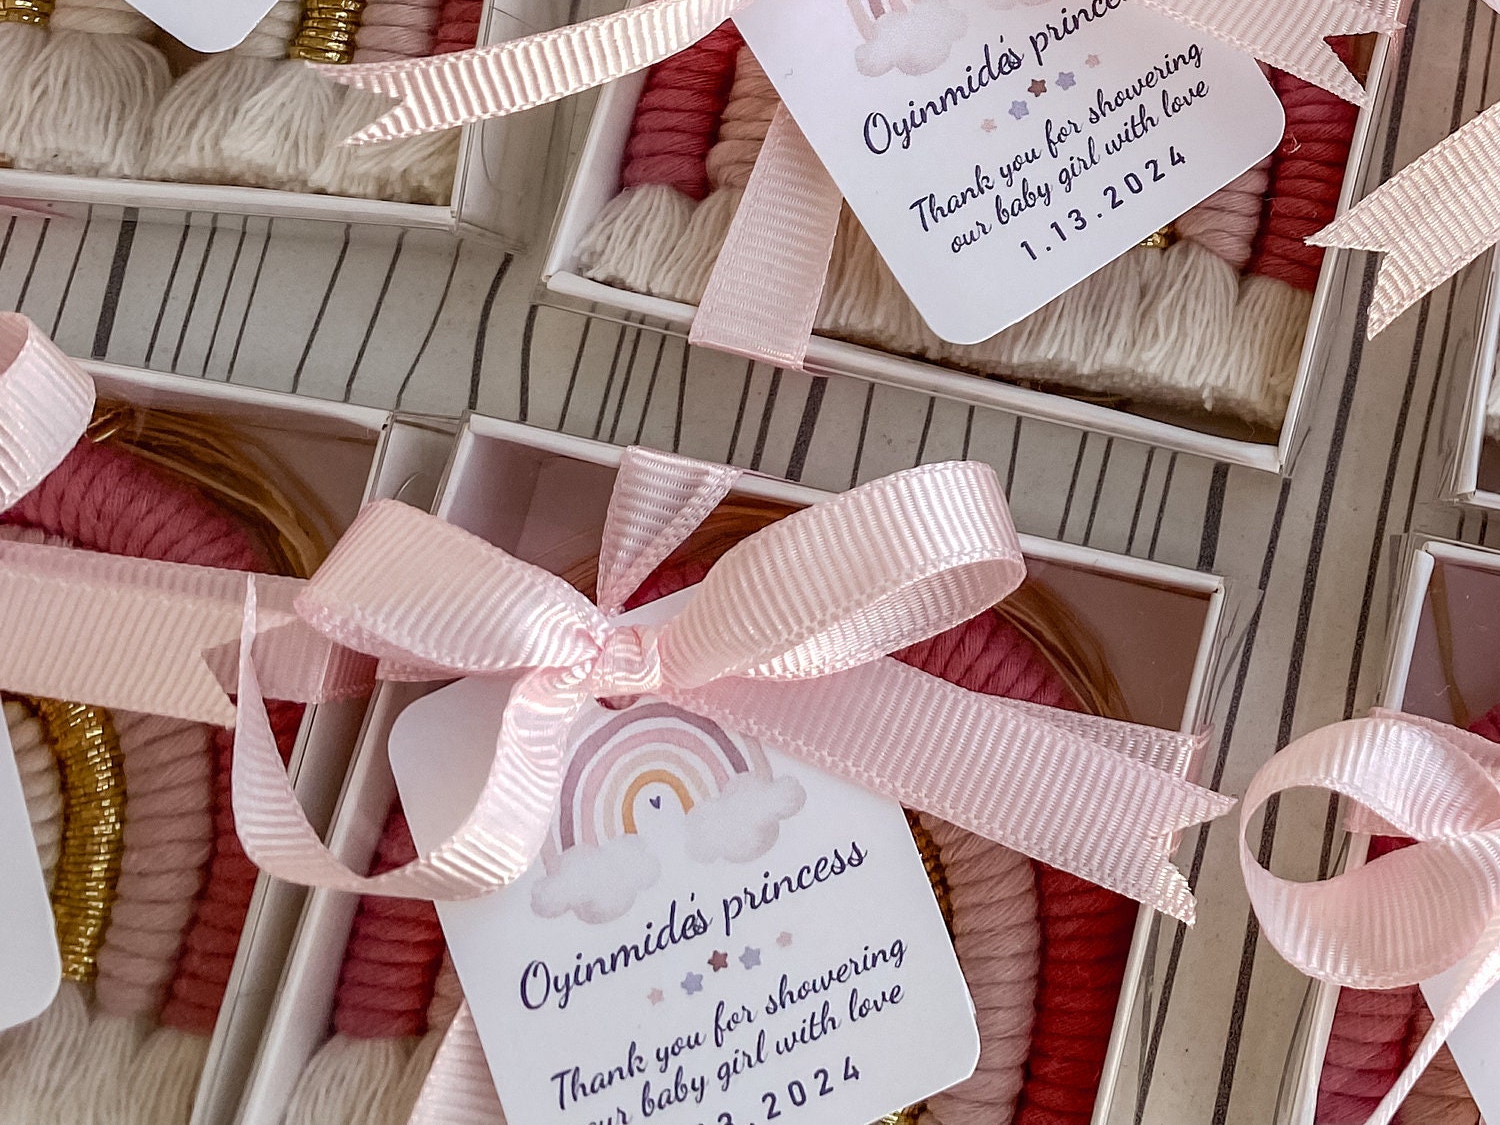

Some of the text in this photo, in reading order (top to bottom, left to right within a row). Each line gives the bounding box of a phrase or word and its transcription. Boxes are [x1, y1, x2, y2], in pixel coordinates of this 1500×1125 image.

[908, 44, 1202, 232] Thank you for showering
[950, 81, 1209, 253] our baby girl with love
[1020, 146, 1186, 260] 1.13.2024
[723, 843, 868, 936] princess
[549, 939, 906, 1110] Thank you for showering
[640, 1065, 705, 1117] baby
[715, 1028, 765, 1091] girl
[775, 999, 842, 1054] with
[849, 984, 903, 1021] love
